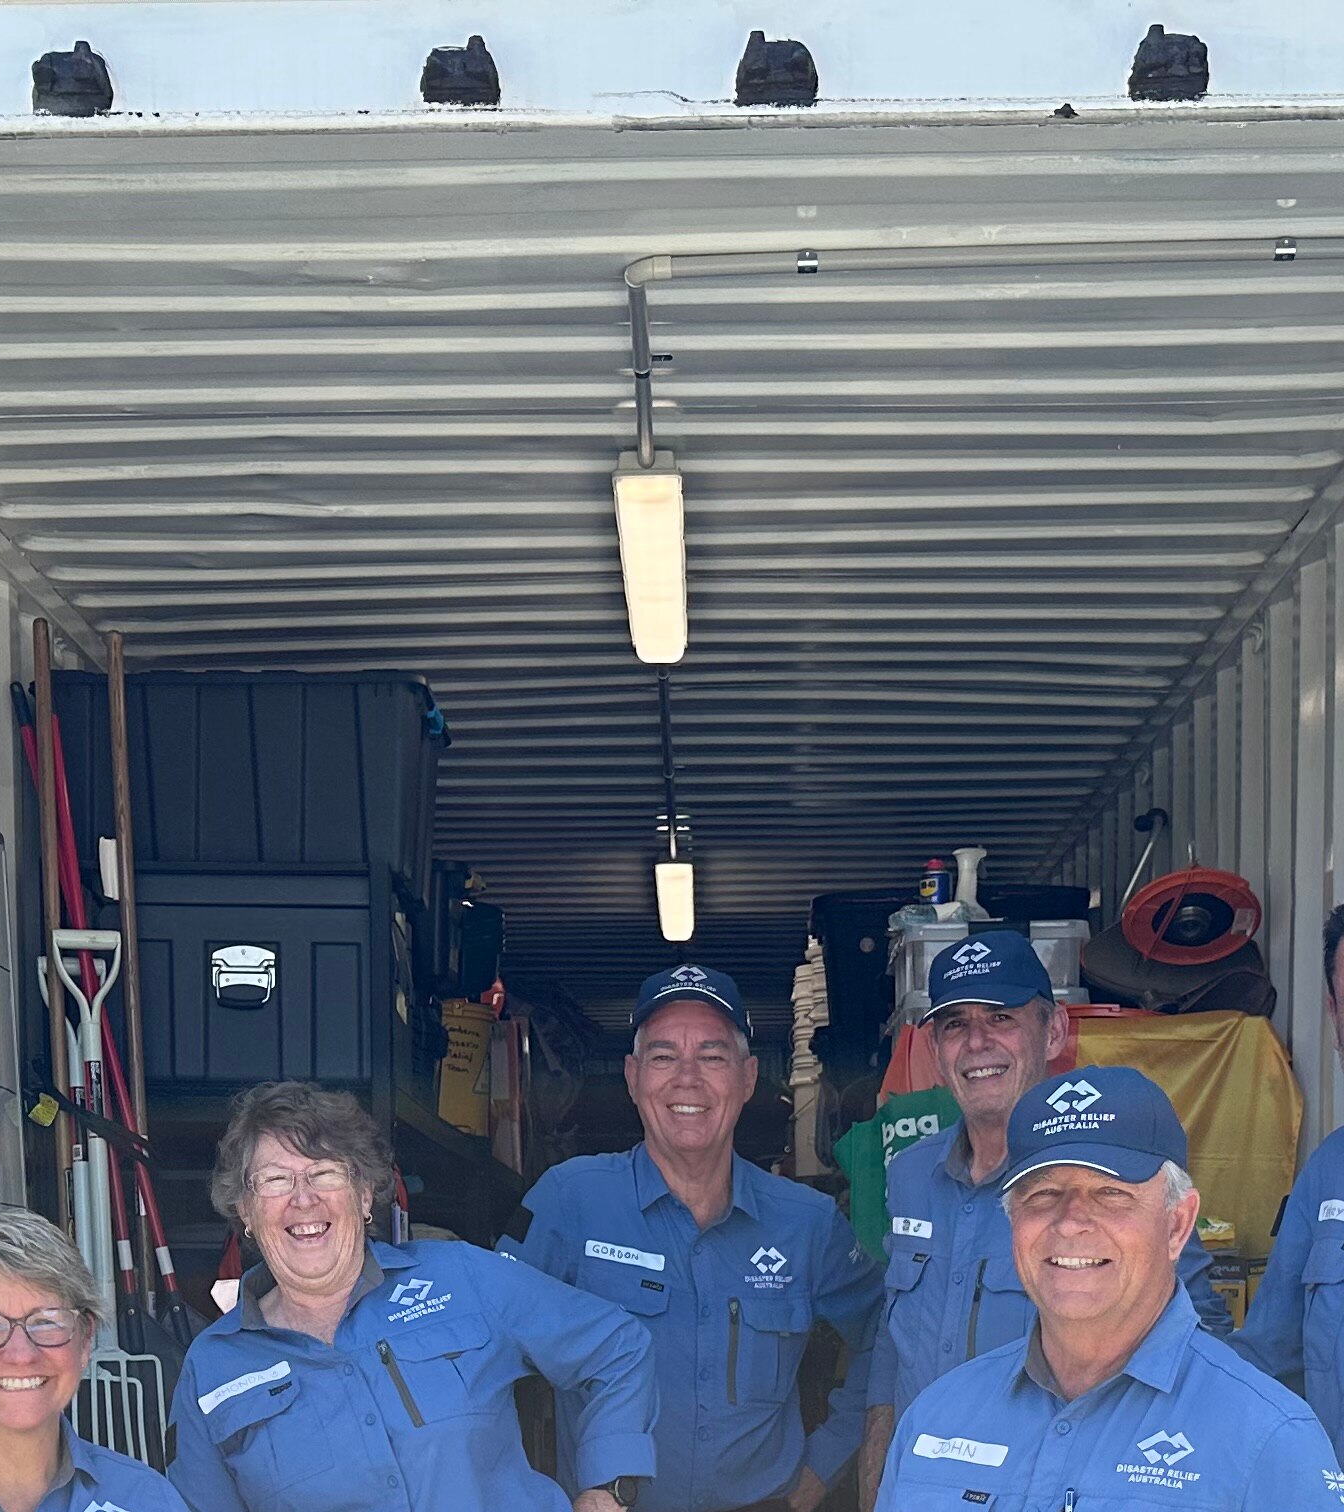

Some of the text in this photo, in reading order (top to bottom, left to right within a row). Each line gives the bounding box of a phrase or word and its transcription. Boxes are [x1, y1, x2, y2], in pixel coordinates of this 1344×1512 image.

[881, 1114, 940, 1147] bag
[1032, 1113, 1116, 1131] DISASTER RELIEF
[1044, 1122, 1100, 1136] AUSTRALIA
[591, 1244, 640, 1261] GORDON
[387, 1293, 452, 1322] DISASTER RELIEF
[403, 1304, 446, 1323] AUSTRALIA
[213, 1372, 266, 1401] RHONDA
[931, 1441, 978, 1459] JOHN
[1116, 1464, 1201, 1482] DISASTER RELIEF
[1128, 1474, 1183, 1490] AUSTRALIA
